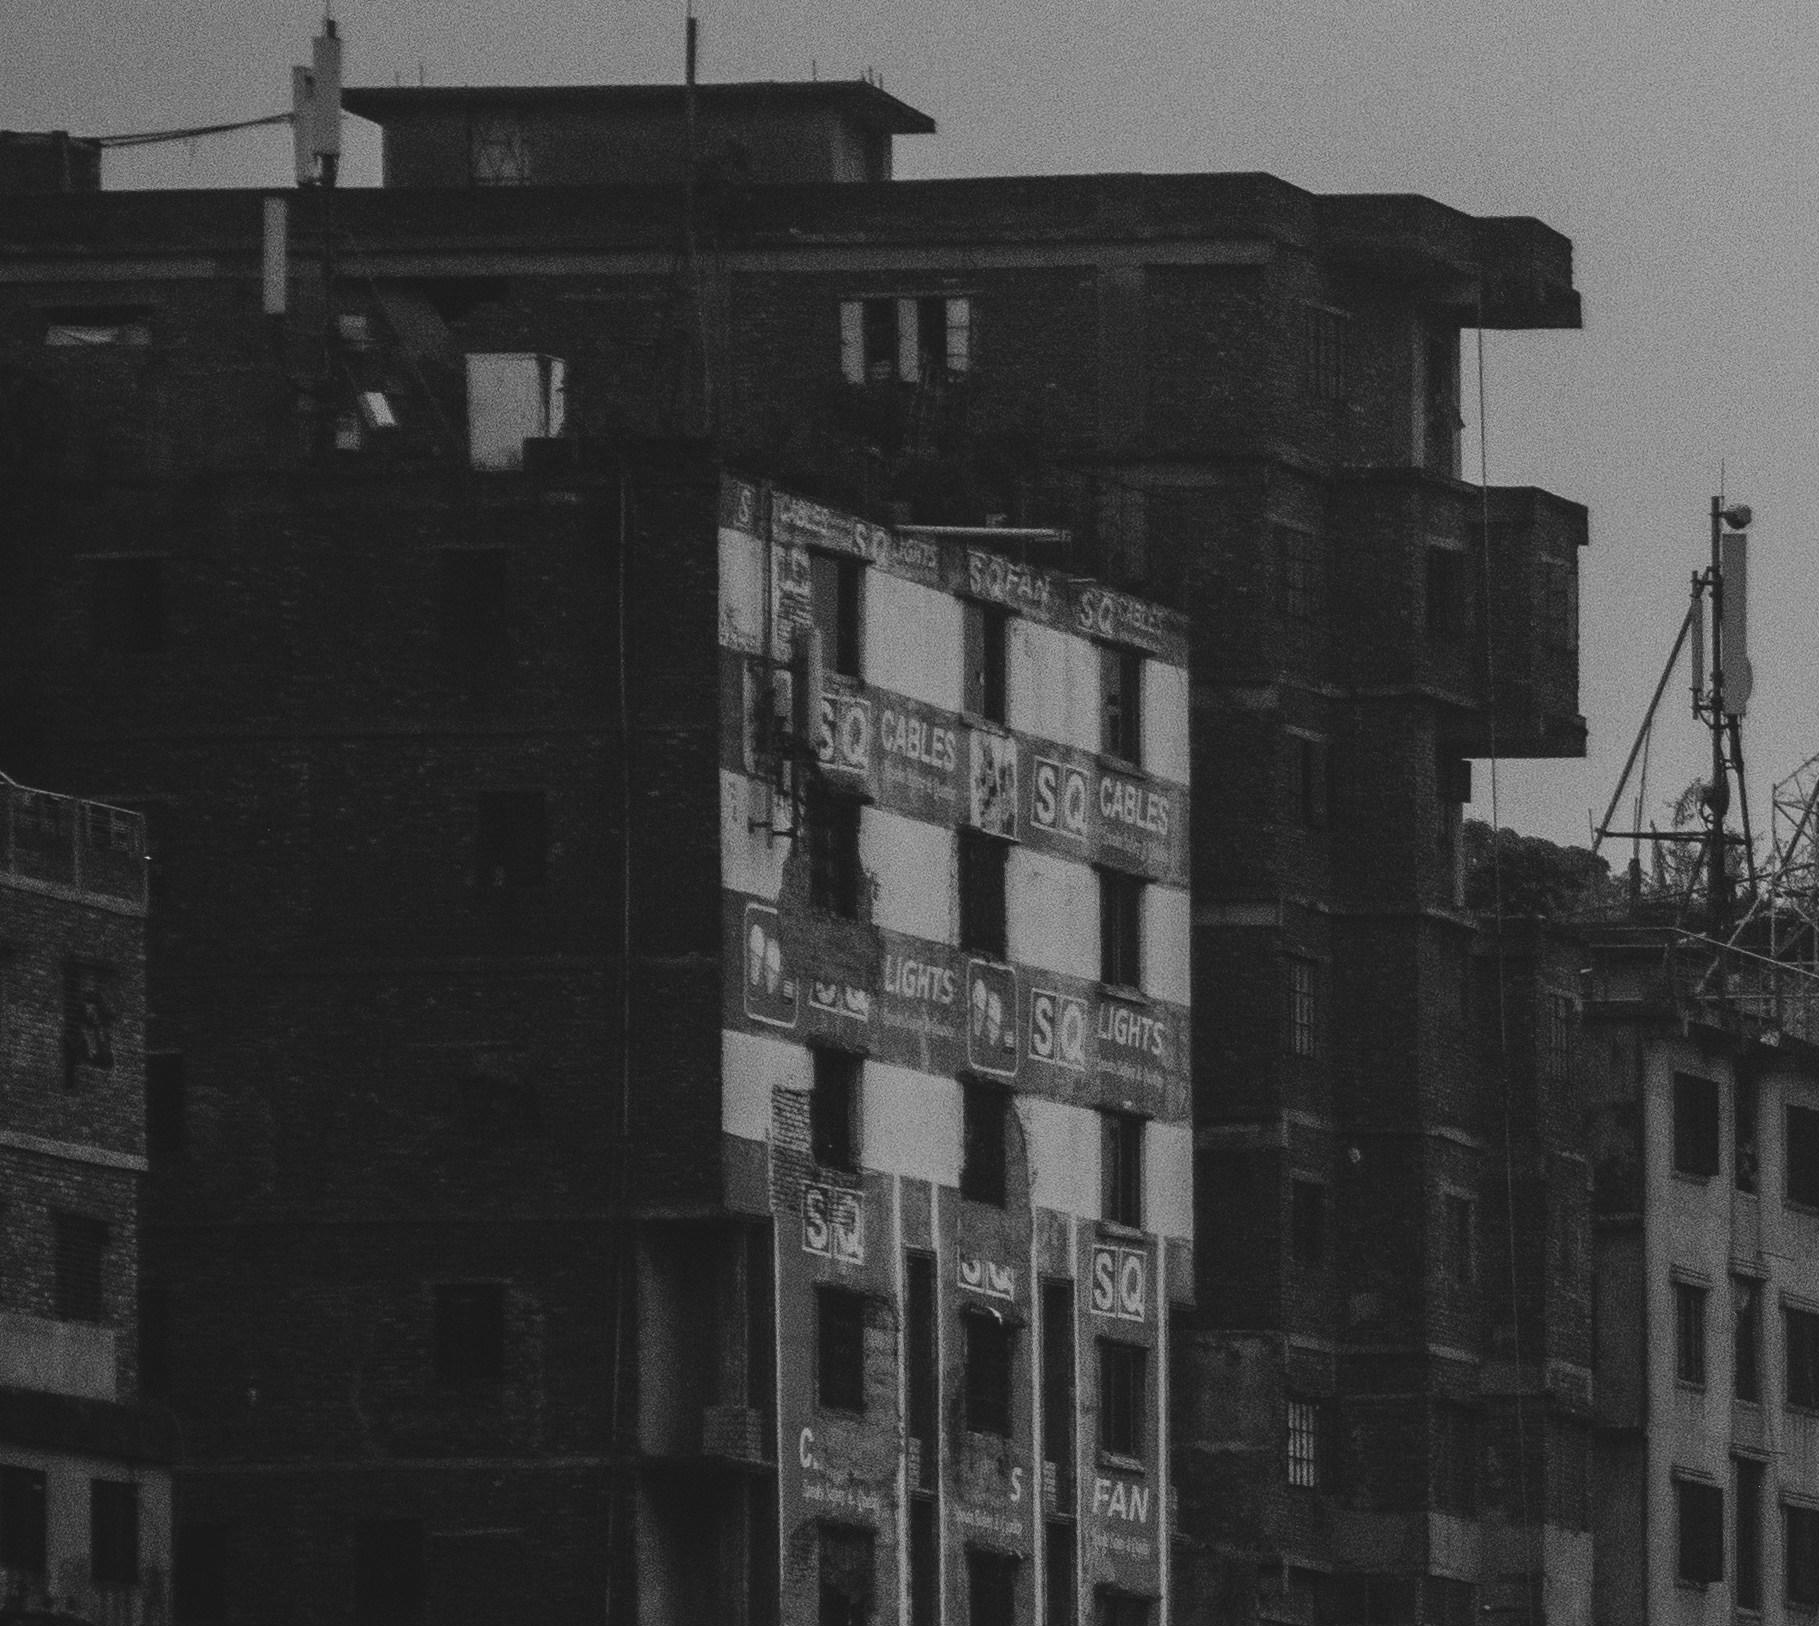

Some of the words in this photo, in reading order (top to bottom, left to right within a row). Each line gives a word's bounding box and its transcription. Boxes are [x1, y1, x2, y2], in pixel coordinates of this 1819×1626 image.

[969, 553, 1003, 598] SQ
[1004, 561, 1050, 602] FAN
[1080, 592, 1114, 637] SQ
[817, 700, 869, 765] SQ
[880, 709, 957, 771] CABLES
[1035, 766, 1088, 833] SQ
[1099, 777, 1169, 835] CABLES
[883, 954, 956, 1004] LIGHTS
[1033, 996, 1085, 1064] SQ
[1099, 1001, 1166, 1056] LIGHTS
[806, 1188, 863, 1255] SQ
[1093, 1252, 1145, 1313] SQ
[1092, 1477, 1150, 1523] FAN
